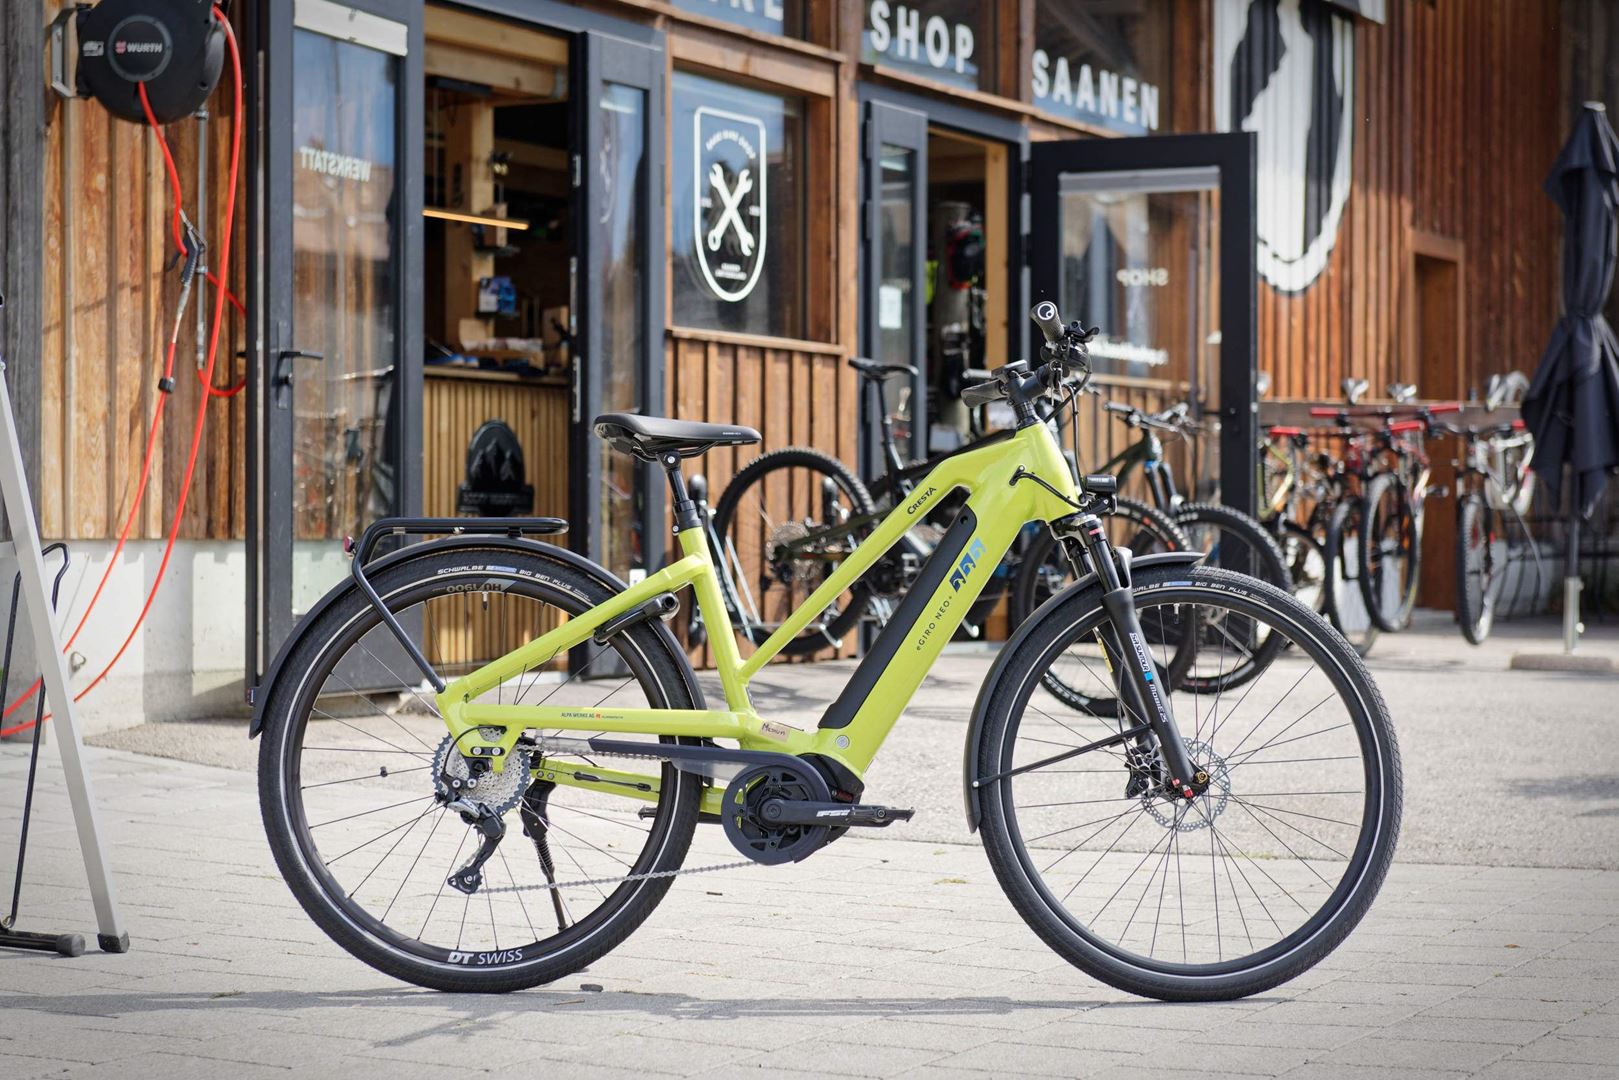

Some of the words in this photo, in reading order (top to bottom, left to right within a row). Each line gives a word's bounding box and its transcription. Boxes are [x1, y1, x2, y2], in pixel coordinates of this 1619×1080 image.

[870, 0, 974, 73] SHOP
[1031, 49, 1159, 130] SAANEN
[437, 565, 484, 575] SCHWALBE
[552, 579, 572, 590] PLUS
[1228, 586, 1248, 596] PLUS
[447, 951, 475, 964] DT
[477, 948, 523, 965] SWISS
